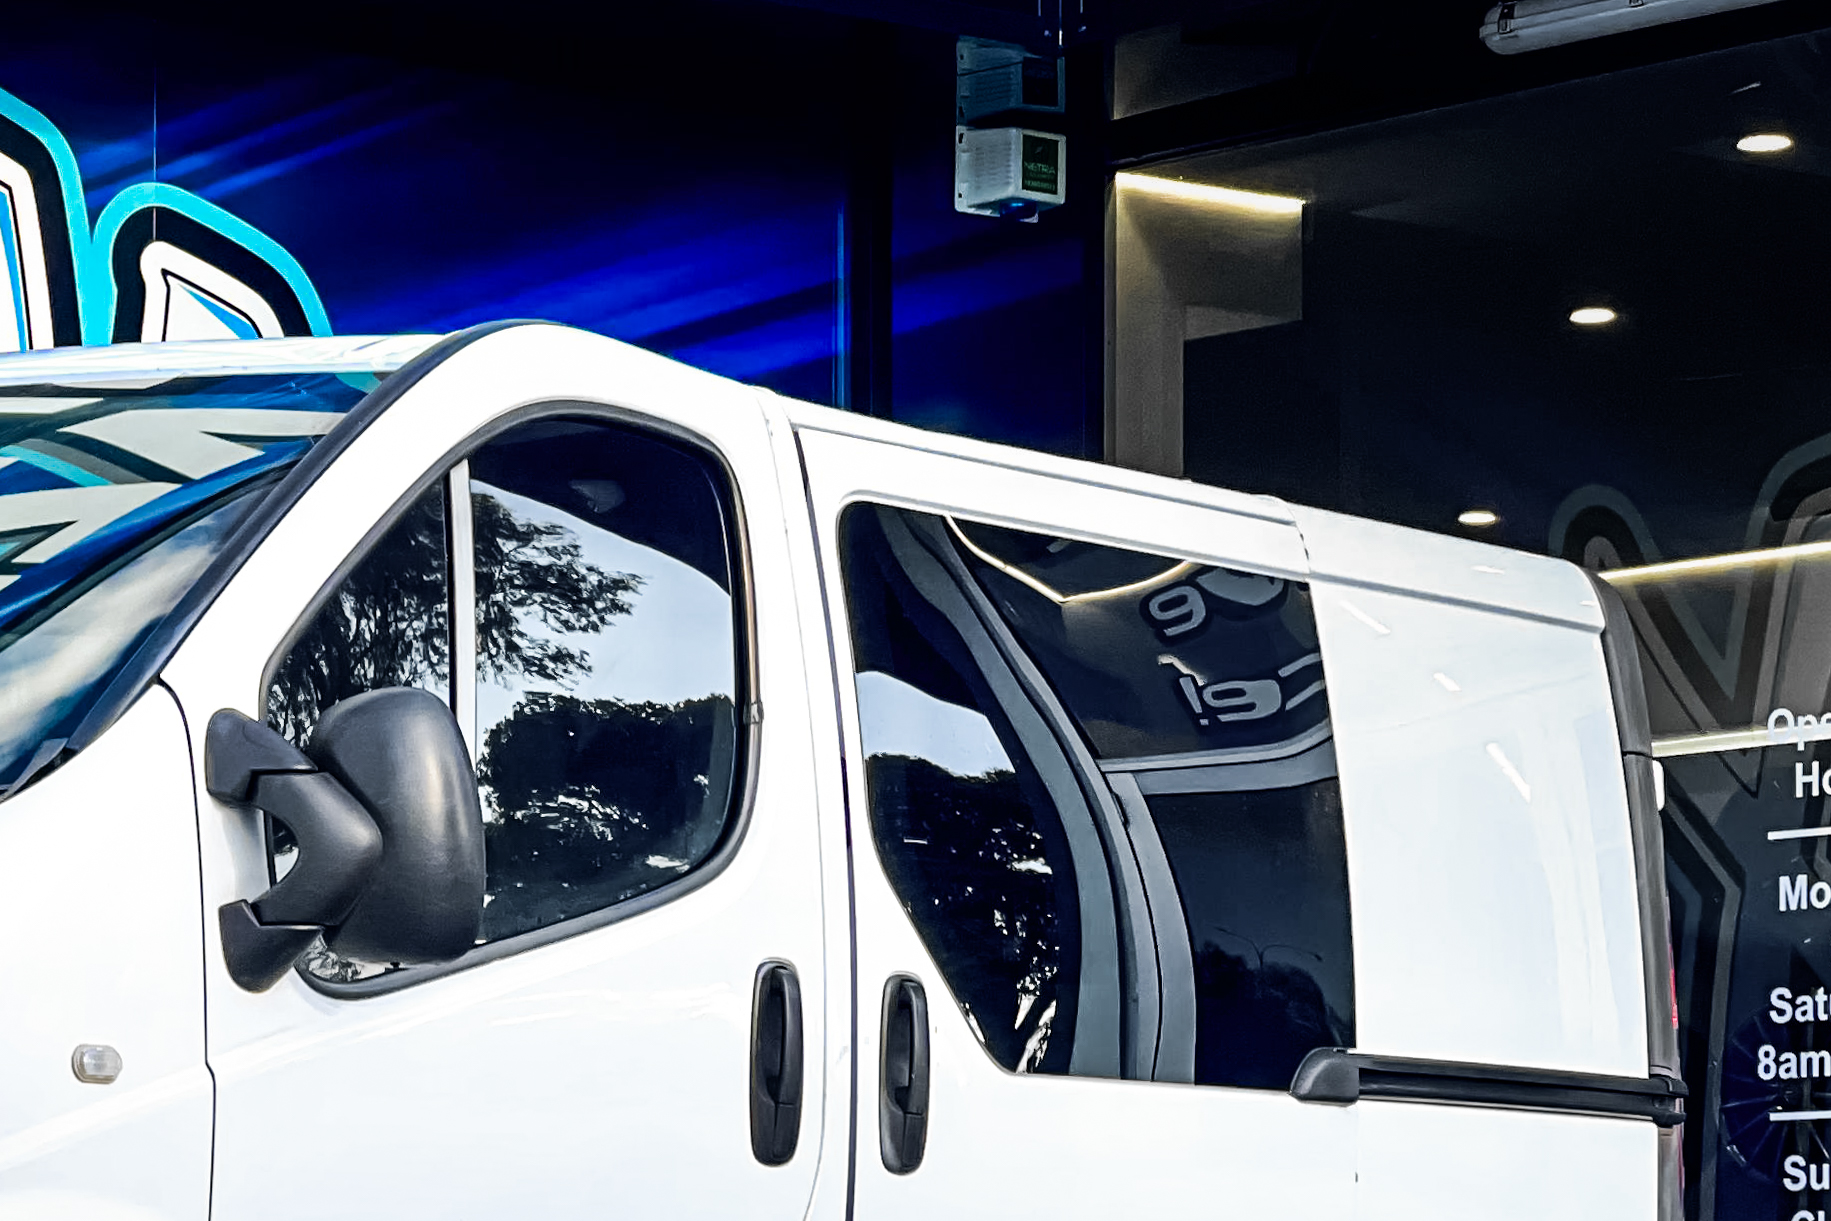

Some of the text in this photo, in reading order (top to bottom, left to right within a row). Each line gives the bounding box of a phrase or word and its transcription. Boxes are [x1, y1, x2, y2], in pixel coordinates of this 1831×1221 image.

[1779, 874, 1831, 912] Mo
[1769, 986, 1831, 1024] Sat
[1783, 1155, 1830, 1192] Su
